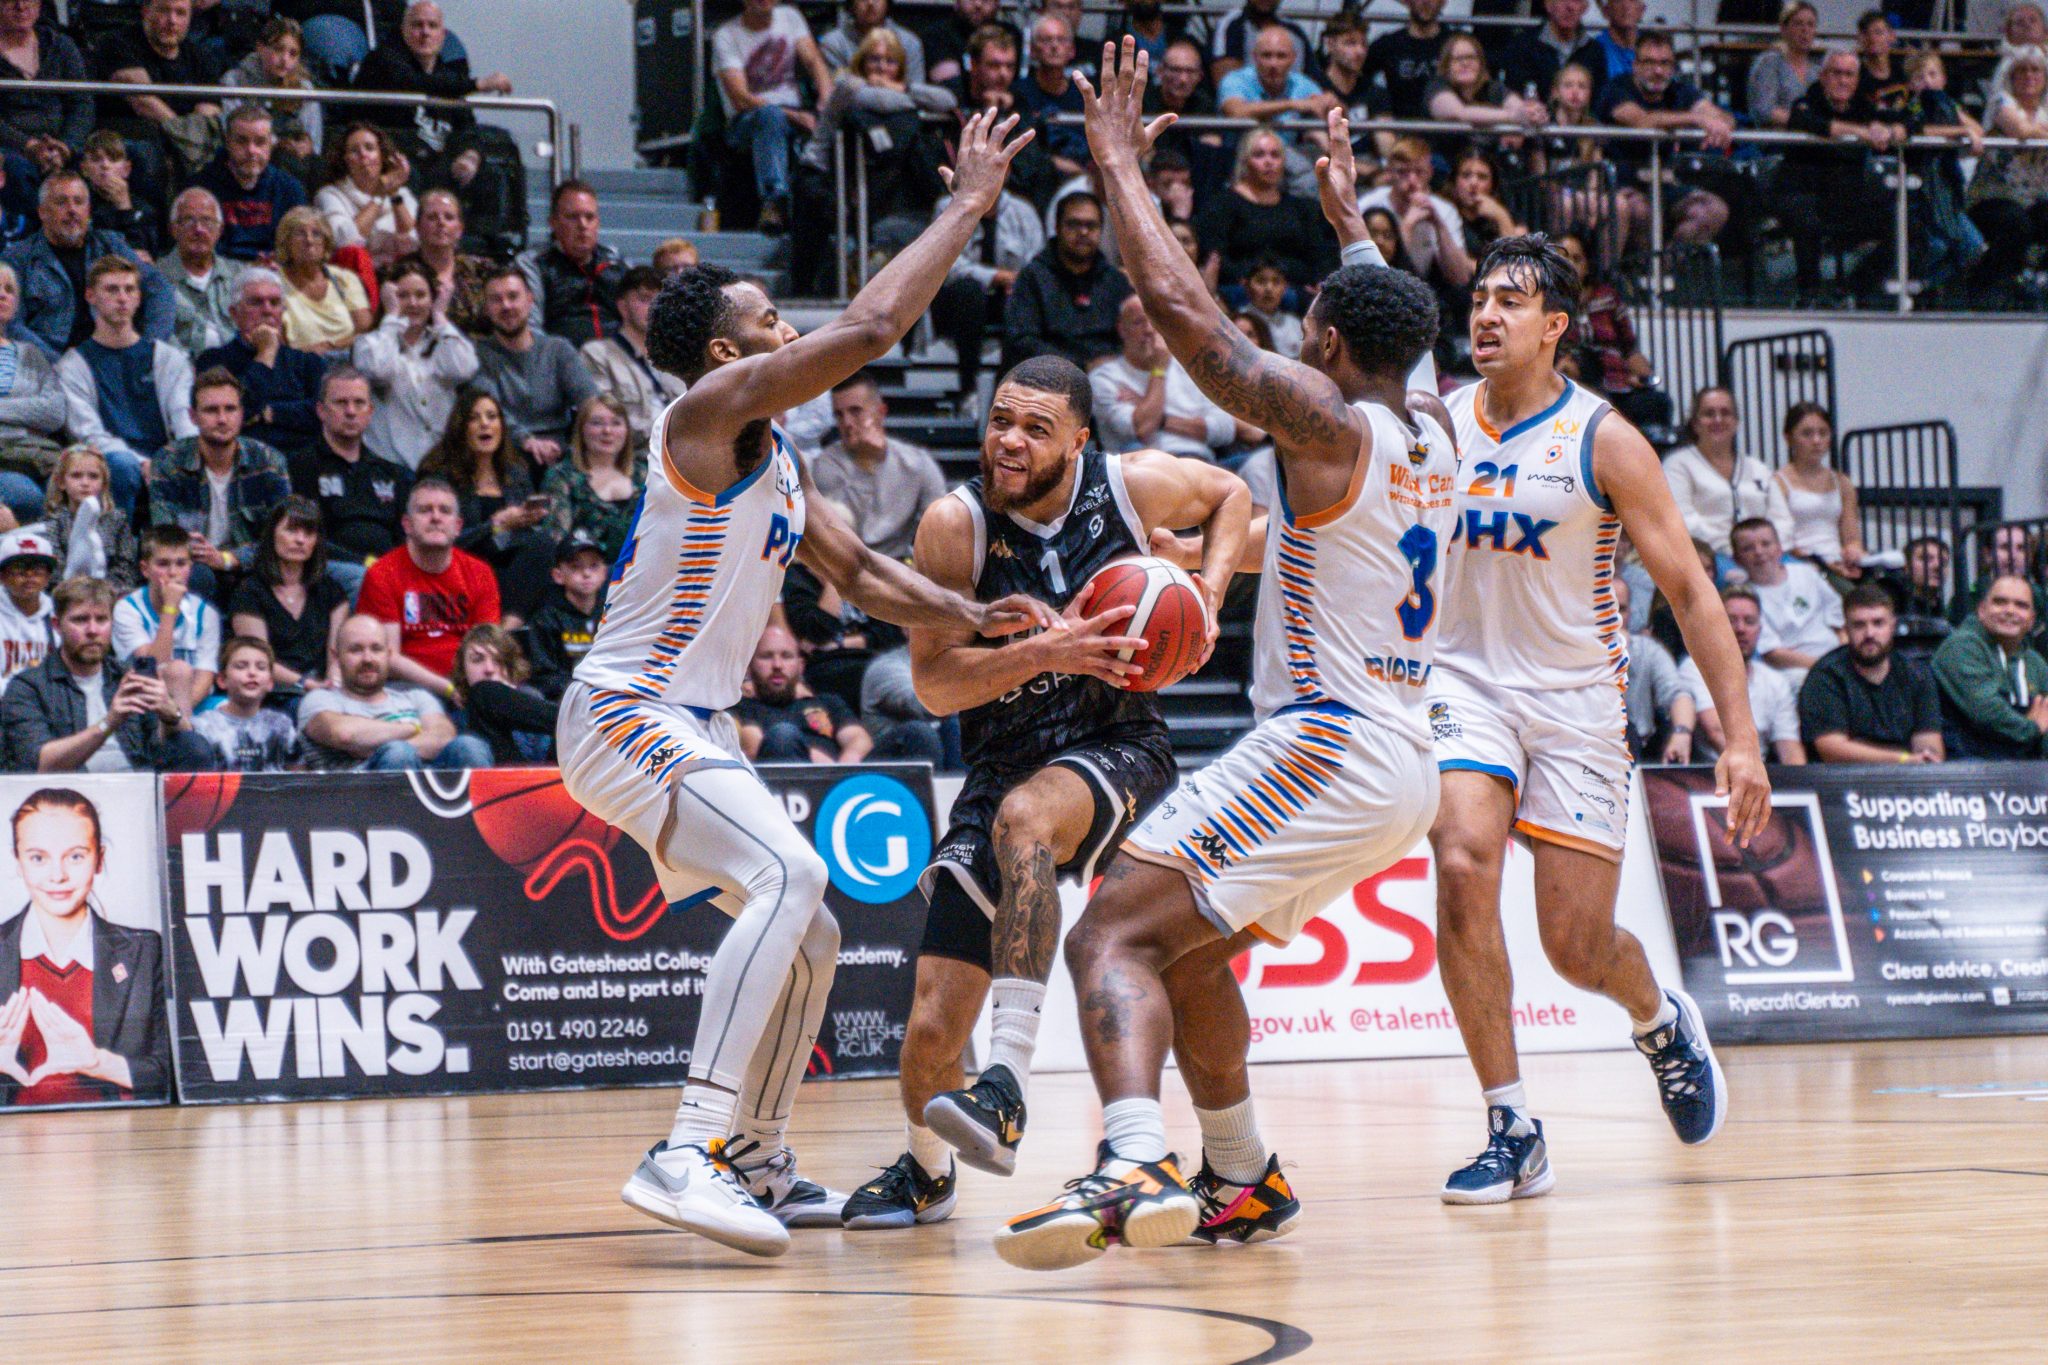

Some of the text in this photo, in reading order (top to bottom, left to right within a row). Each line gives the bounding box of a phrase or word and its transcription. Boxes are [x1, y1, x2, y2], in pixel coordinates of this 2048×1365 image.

[1464, 461, 1519, 498] 21
[1040, 550, 1066, 594] 1
[1847, 790, 2048, 822] Supporting Your
[1853, 823, 1962, 849] Business
[180, 829, 433, 914] HARD
[1230, 857, 1438, 989] SS
[1714, 912, 1798, 967] RG
[184, 910, 483, 998] WORK
[502, 955, 547, 975] With
[550, 952, 651, 975] Gateshead
[1881, 962, 1929, 980] Clear
[1932, 959, 1998, 979] advice,
[503, 982, 560, 1001] Come
[563, 980, 598, 999] and
[601, 979, 625, 998] be
[629, 979, 669, 1002] part
[671, 977, 691, 996] of
[189, 993, 470, 1082] WINS.
[506, 1018, 649, 1042] 0191 490 2246
